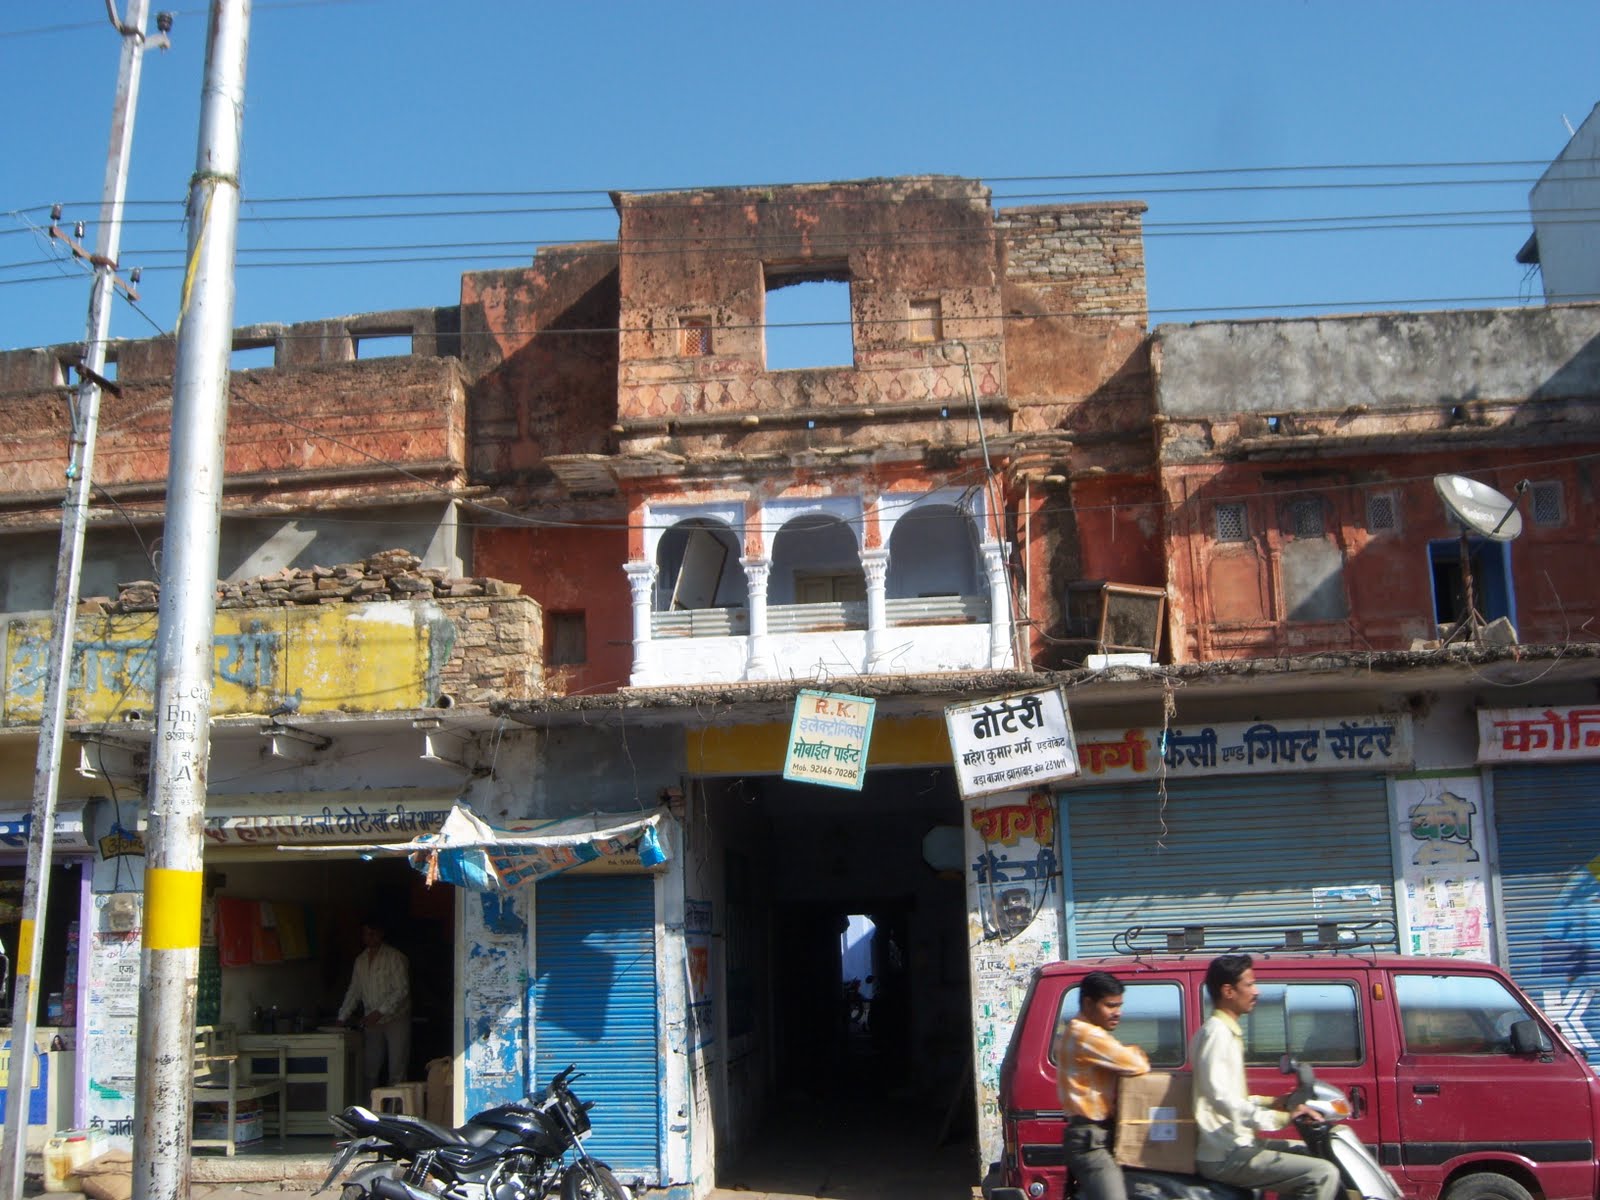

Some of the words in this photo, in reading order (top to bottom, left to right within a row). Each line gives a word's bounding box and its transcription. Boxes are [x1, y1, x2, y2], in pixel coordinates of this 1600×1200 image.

[971, 696, 1044, 740] नोटेरी
[962, 748, 985, 768] महेश
[987, 744, 1013, 766] कुमार
[1014, 737, 1032, 755] गर्ग
[416, 811, 450, 831] भण्डा
[971, 792, 1054, 848] गर्ग
